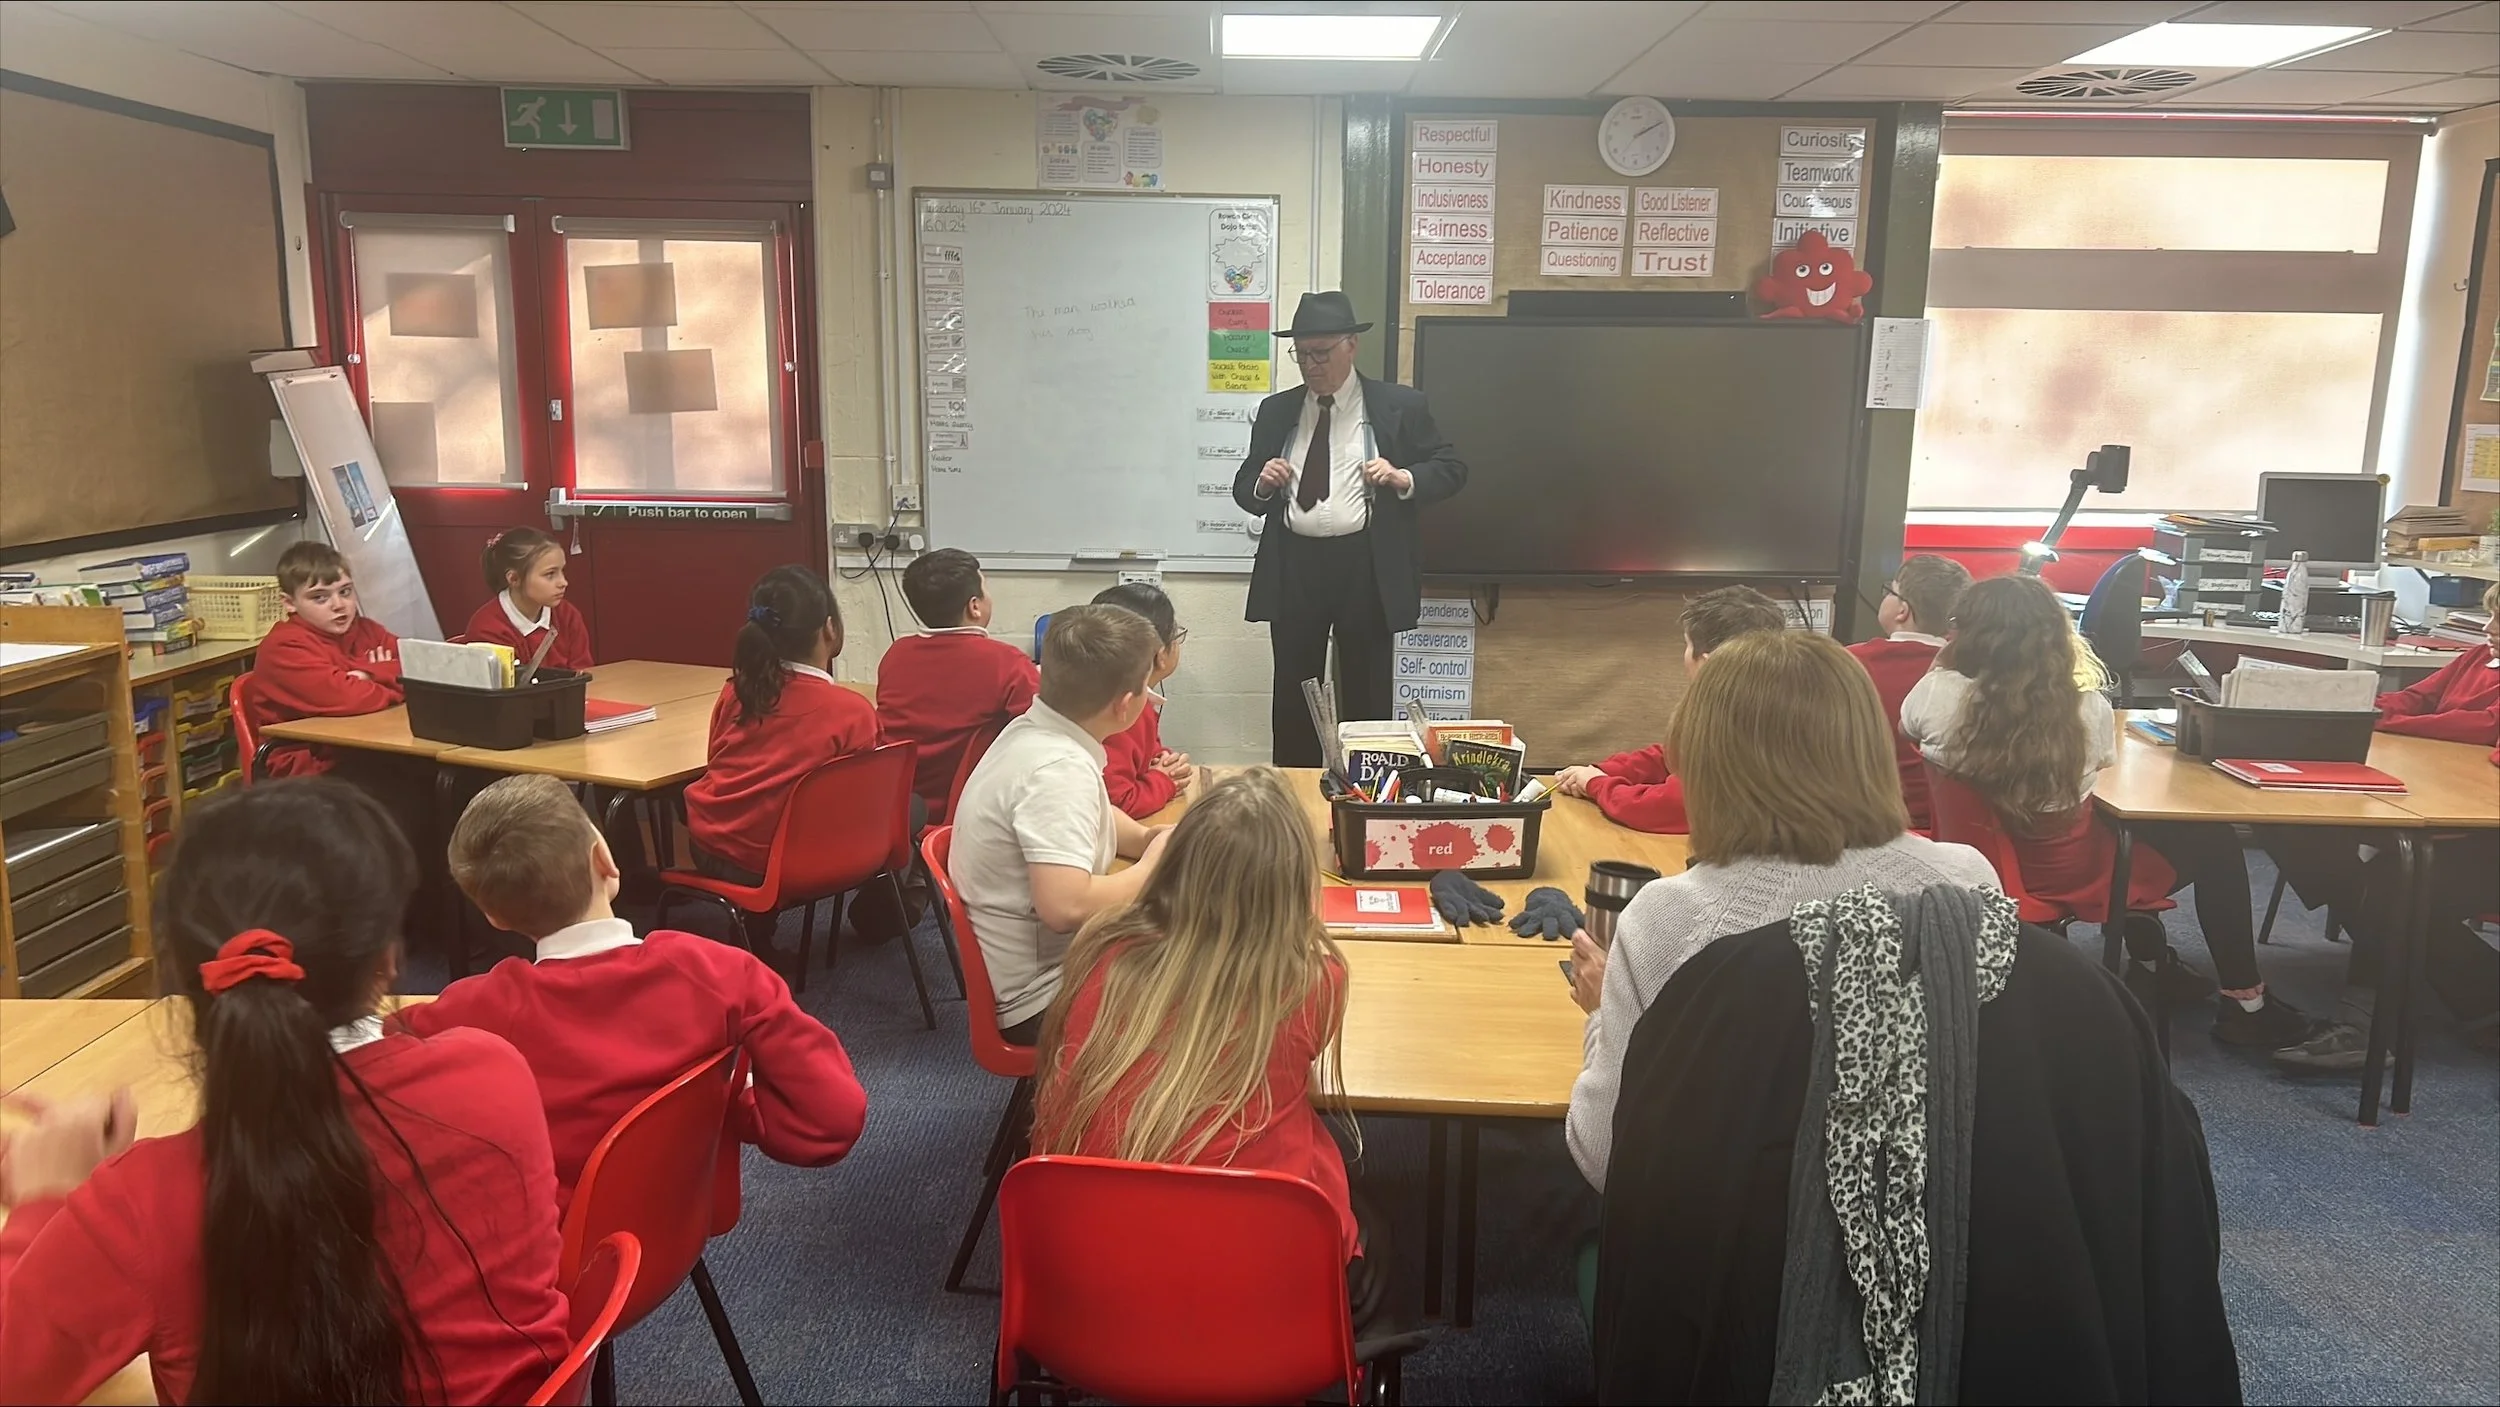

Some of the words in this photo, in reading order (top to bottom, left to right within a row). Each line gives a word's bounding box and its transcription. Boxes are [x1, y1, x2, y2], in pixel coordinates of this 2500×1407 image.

[1419, 126, 1491, 145] Respectful
[1787, 131, 1857, 151] Curiosity
[1418, 157, 1489, 177] Honesty
[1784, 162, 1854, 182] Teamwork
[1417, 188, 1489, 208] Inclusiveness
[1550, 189, 1622, 210] Kindness
[1641, 192, 1669, 211] Good
[1671, 192, 1712, 212] Listener
[1039, 202, 1072, 216] 2024
[1417, 217, 1488, 238] Fairness
[1548, 221, 1619, 241] Patience
[1639, 222, 1709, 242] Reflective
[1416, 249, 1486, 268] Acceptance
[1547, 251, 1617, 271] Questioning
[1639, 252, 1708, 271] Trust
[1416, 280, 1486, 299] Tolerance
[628, 506, 664, 517] Push
[668, 506, 691, 518] bar
[694, 508, 709, 519] to
[712, 509, 748, 519] open
[1420, 603, 1469, 618] pendence
[1400, 631, 1468, 649] Perseverance
[1400, 657, 1426, 674] Self-
[1429, 659, 1467, 676] control
[1399, 684, 1466, 700] Optimism
[1360, 752, 1409, 767] ROALD
[1428, 843, 1453, 855] red
